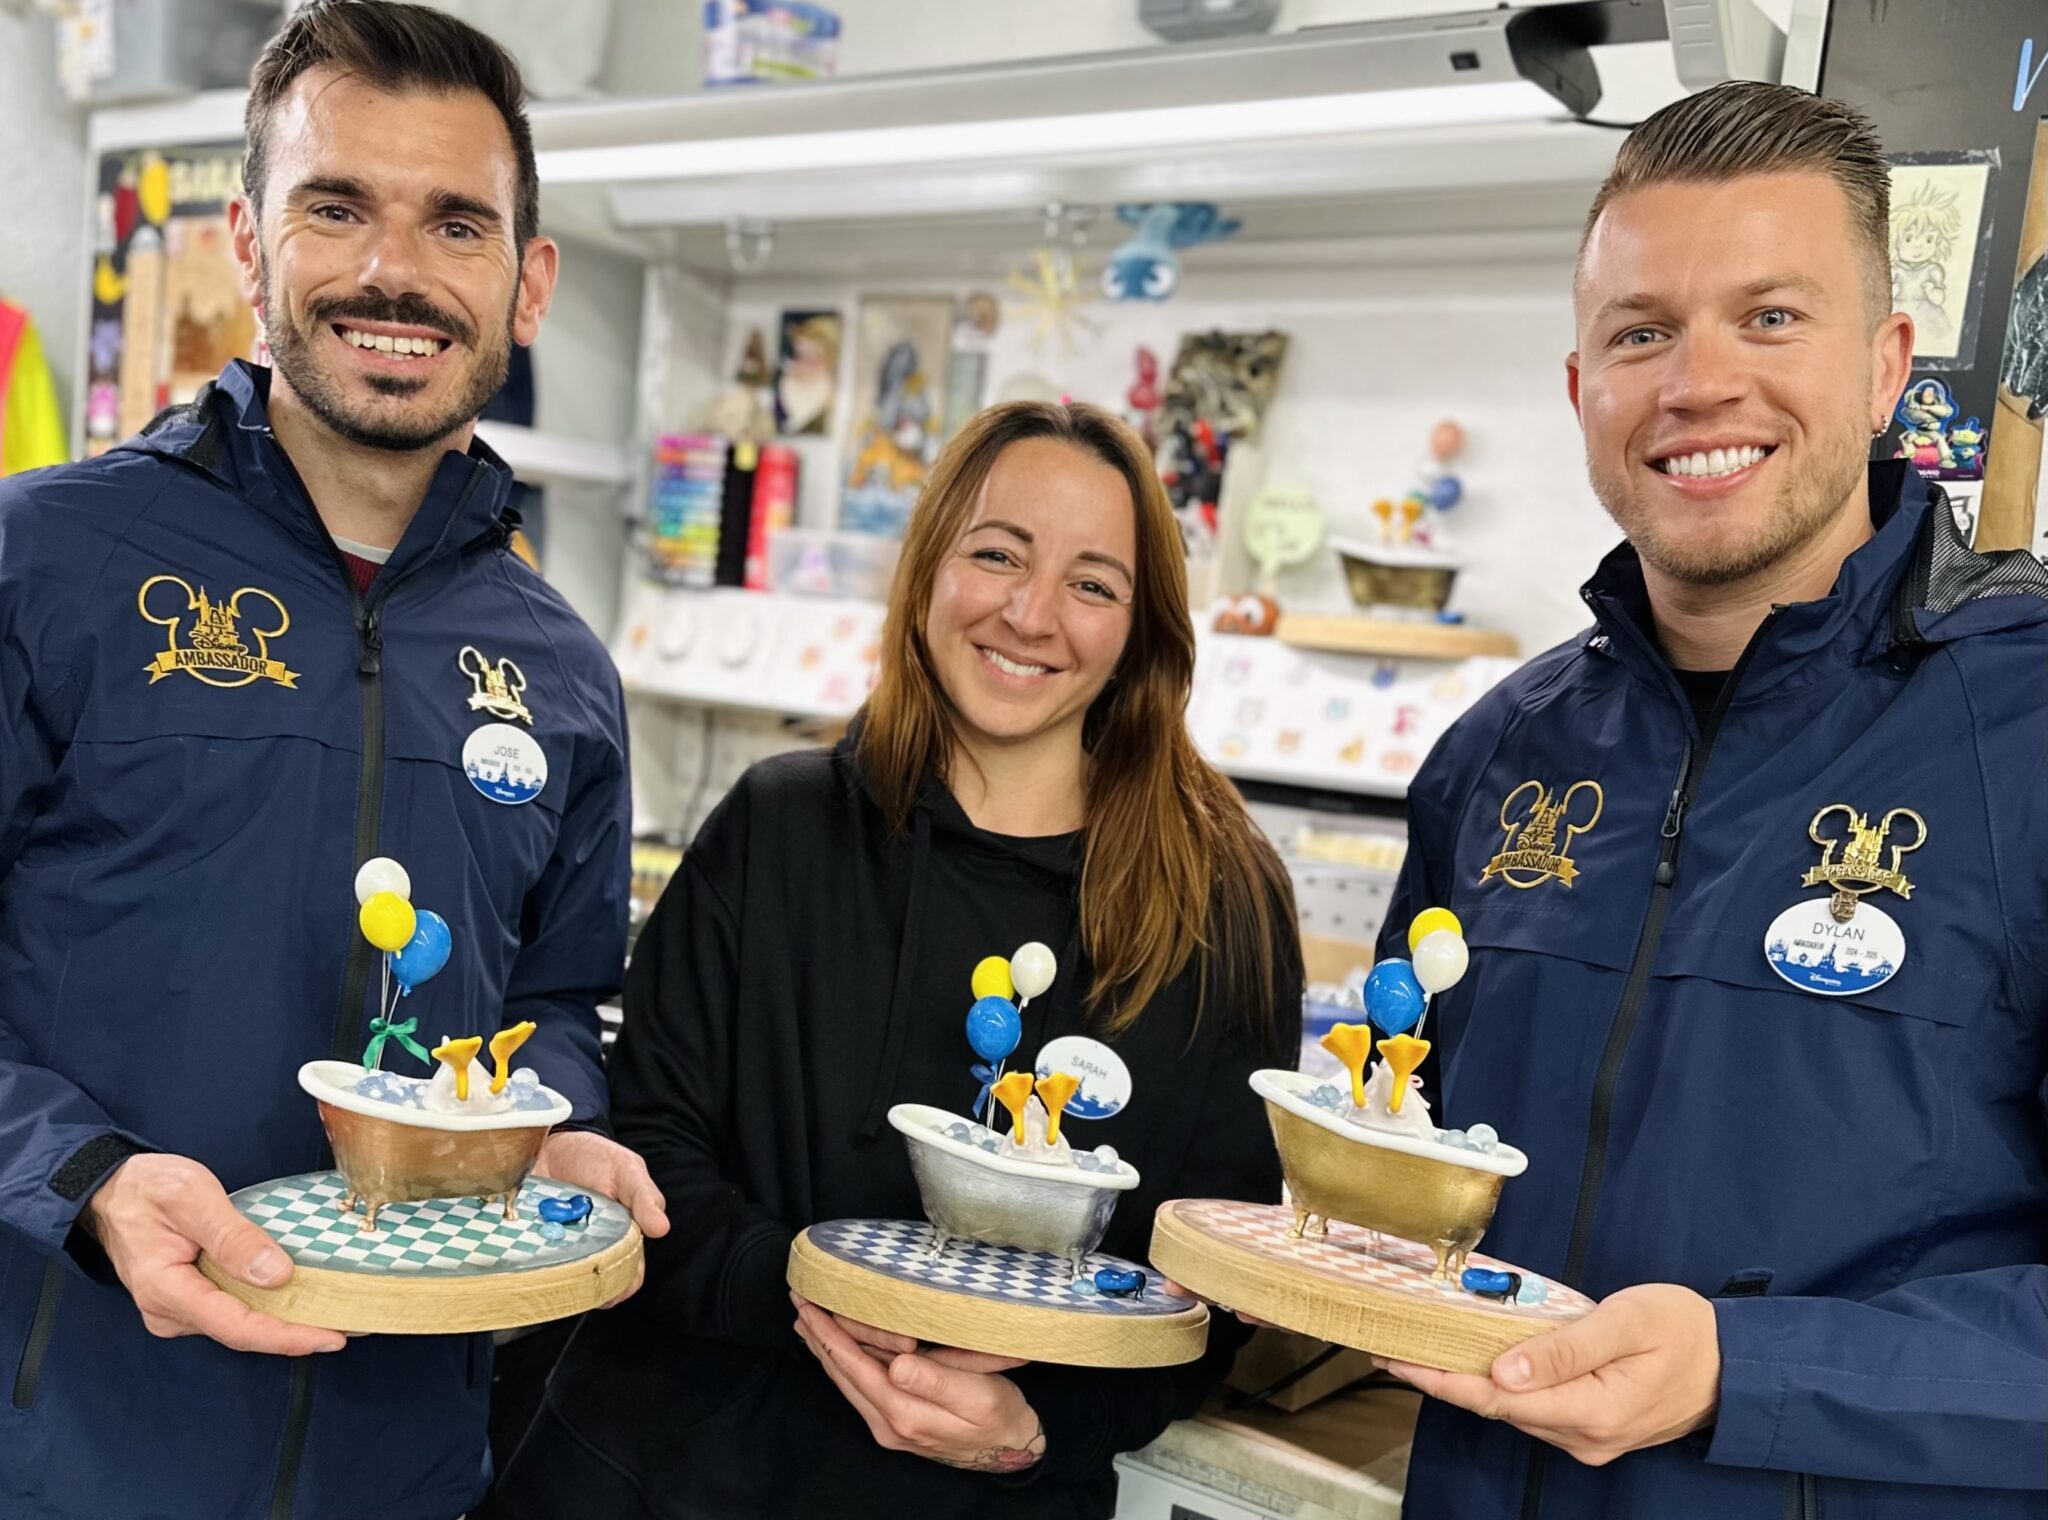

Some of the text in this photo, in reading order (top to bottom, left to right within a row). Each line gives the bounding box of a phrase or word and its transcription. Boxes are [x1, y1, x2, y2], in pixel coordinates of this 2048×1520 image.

[174, 651, 268, 675] AMBASSADOR
[494, 745, 519, 759] JOSE
[1498, 853, 1561, 873] AMBASSADOR
[1812, 922, 1865, 941] DYLAN
[1071, 1056, 1108, 1078] SARAH
